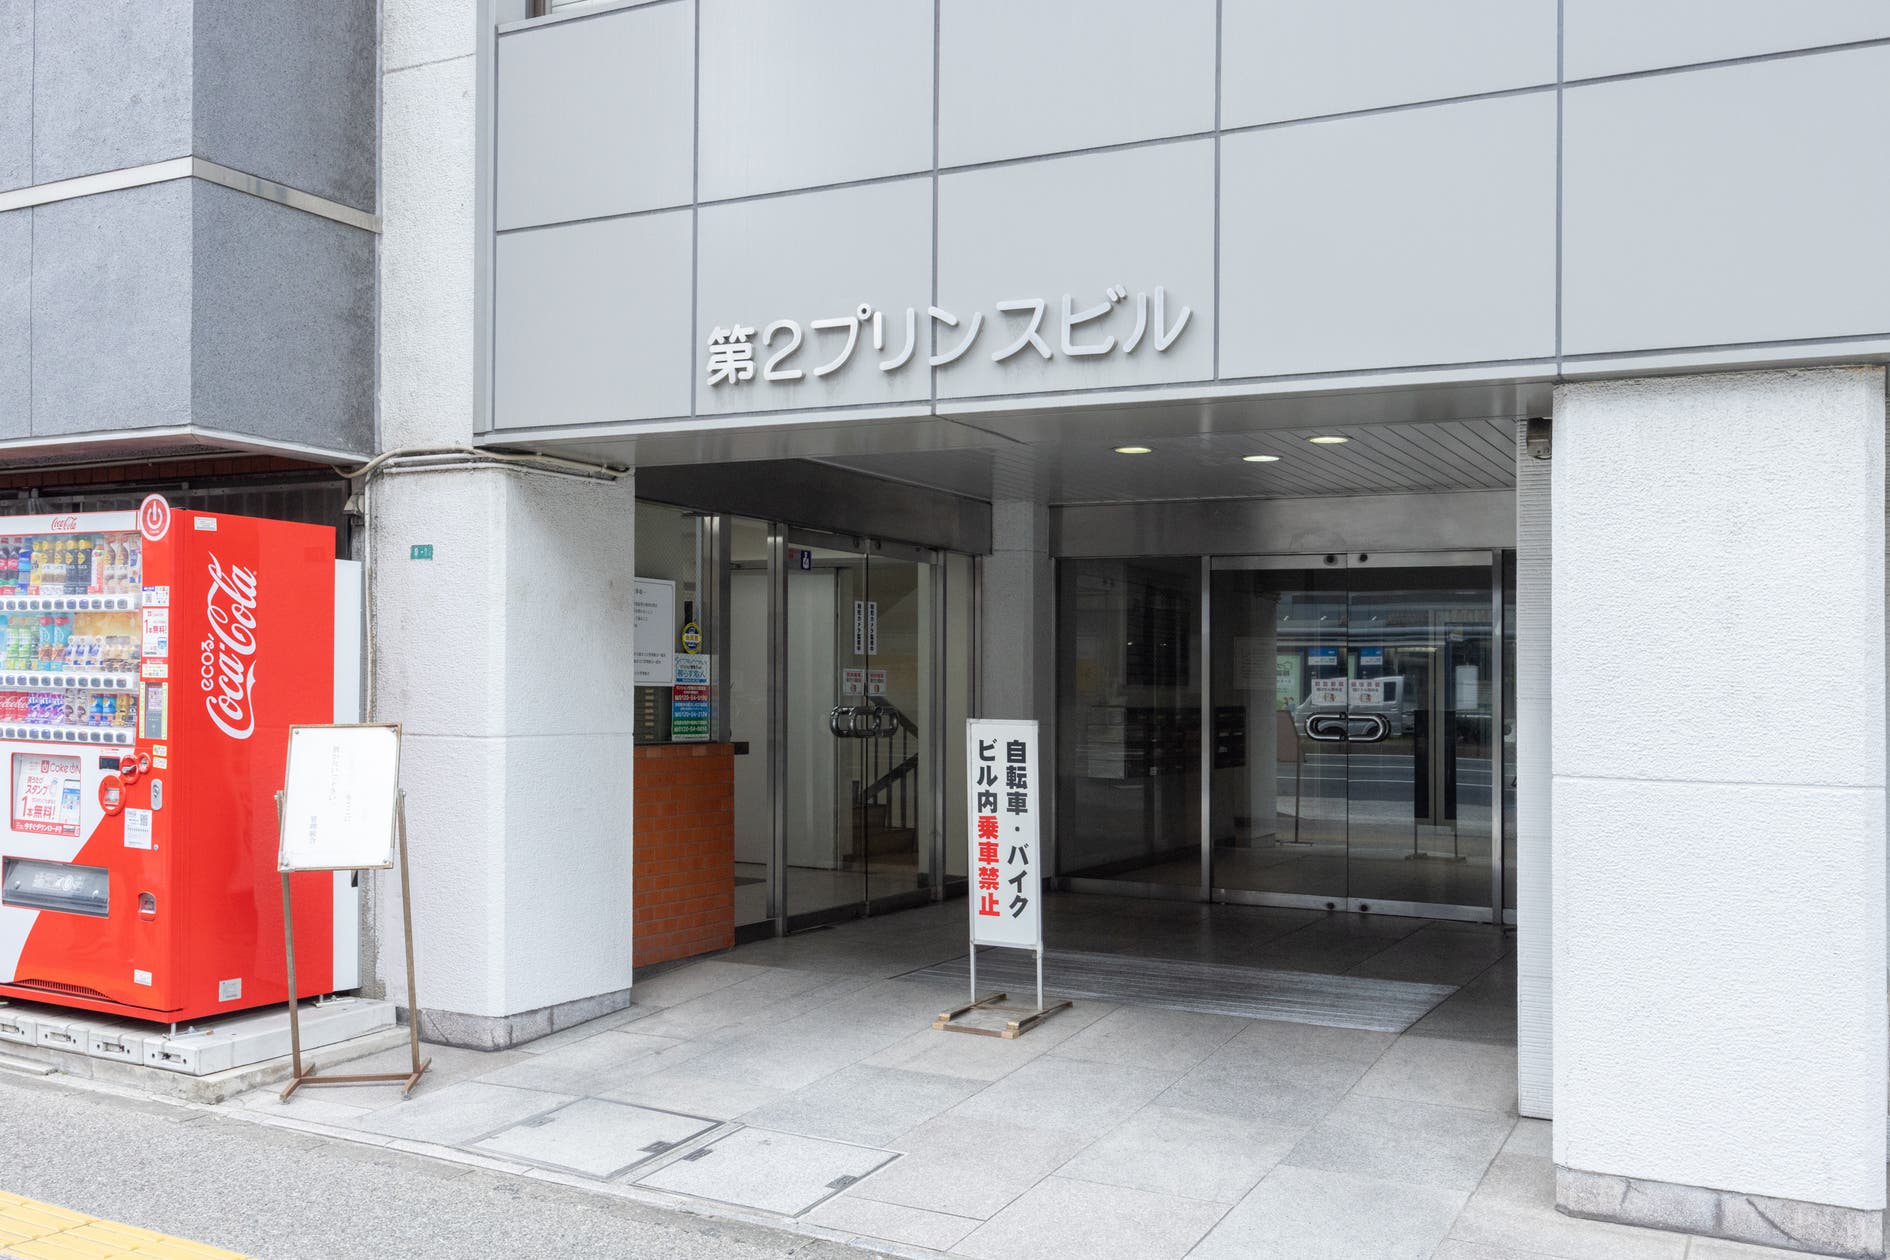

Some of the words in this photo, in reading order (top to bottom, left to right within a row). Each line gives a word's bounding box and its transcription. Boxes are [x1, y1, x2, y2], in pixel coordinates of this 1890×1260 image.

[707, 285, 1191, 387] 第2プリンスビル
[206, 551, 257, 740] Coca-Cola
[50, 762, 69, 773] Coke
[976, 738, 1001, 917] ビル内乗車禁止
[1006, 740, 1030, 919] 自転車・バイク
